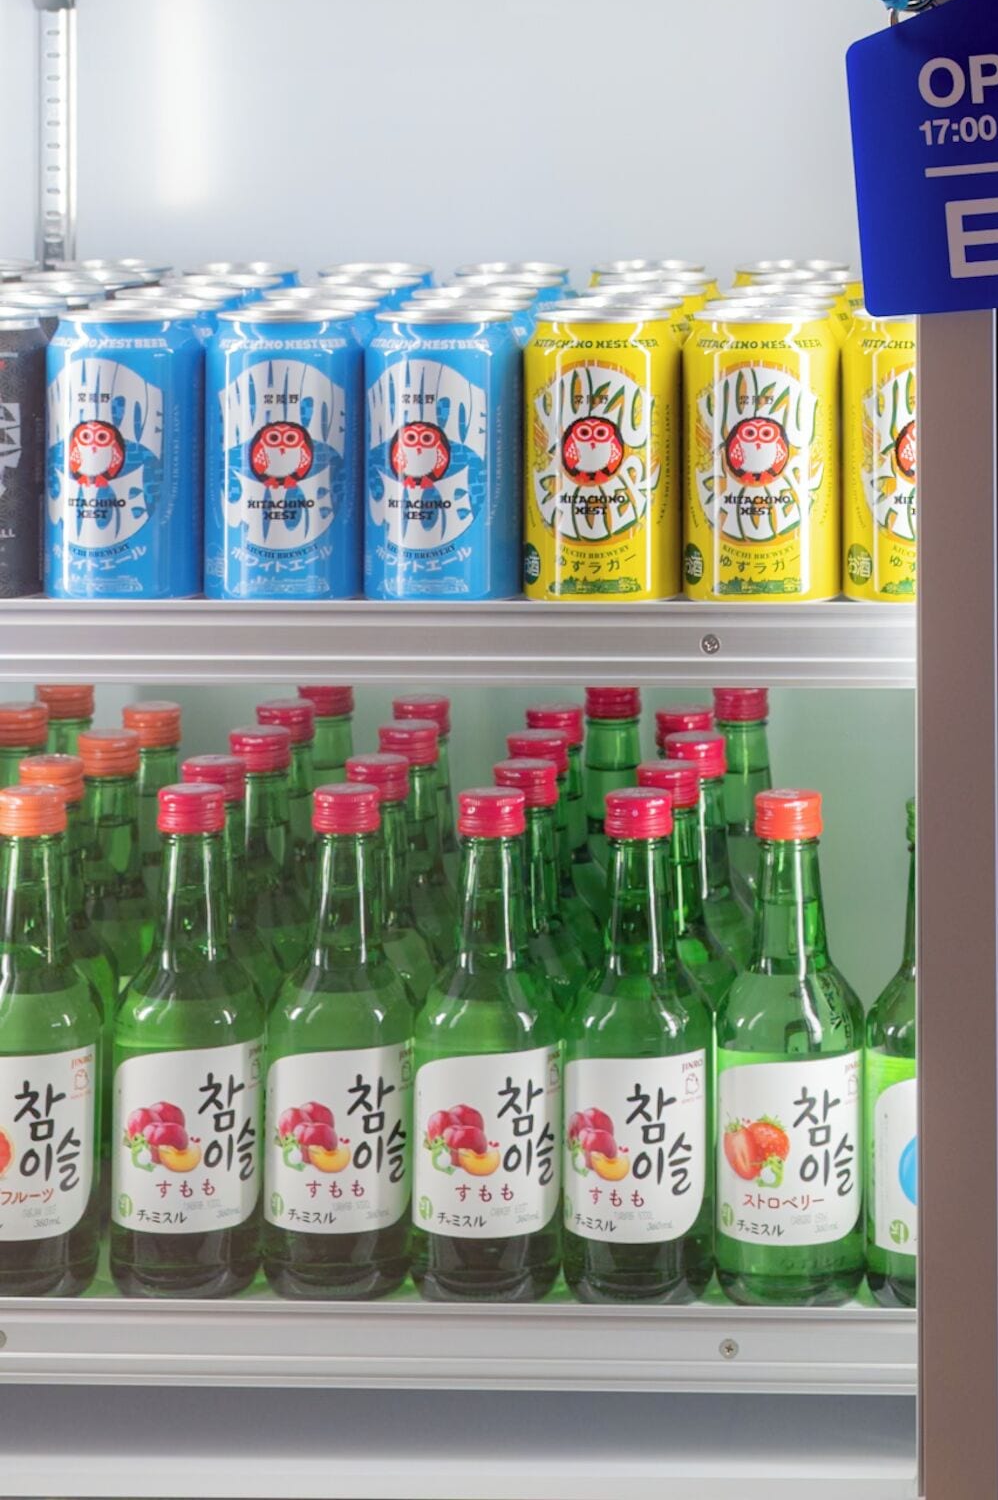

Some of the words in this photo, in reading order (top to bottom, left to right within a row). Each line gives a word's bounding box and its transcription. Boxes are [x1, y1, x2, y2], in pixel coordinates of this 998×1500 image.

[595, 338, 628, 349] NEST
[247, 498, 315, 509] HITACHINO
[559, 493, 626, 505] HITACHINO
[723, 495, 791, 505] HITACHINO
[76, 508, 109, 519] NEST
[264, 509, 298, 520] NEST
[404, 509, 435, 520] NEST
[574, 505, 607, 516] NEST
[739, 505, 773, 516] NEST
[718, 551, 801, 573] ゆずラガー
[681, 1058, 703, 1073] JINRO
[156, 1178, 216, 1199] すもも
[305, 1180, 366, 1198] すもも
[455, 1183, 515, 1203] すもも
[0, 1188, 55, 1206] フルーツ
[589, 1187, 645, 1208] すもも
[742, 1194, 824, 1211] ストロベリー
[137, 1208, 188, 1224] チャミスル
[287, 1208, 337, 1225] チャミスル
[437, 1212, 487, 1228] チャミスル
[574, 1213, 617, 1233] チャミスル
[736, 1219, 785, 1237] チャミスル
